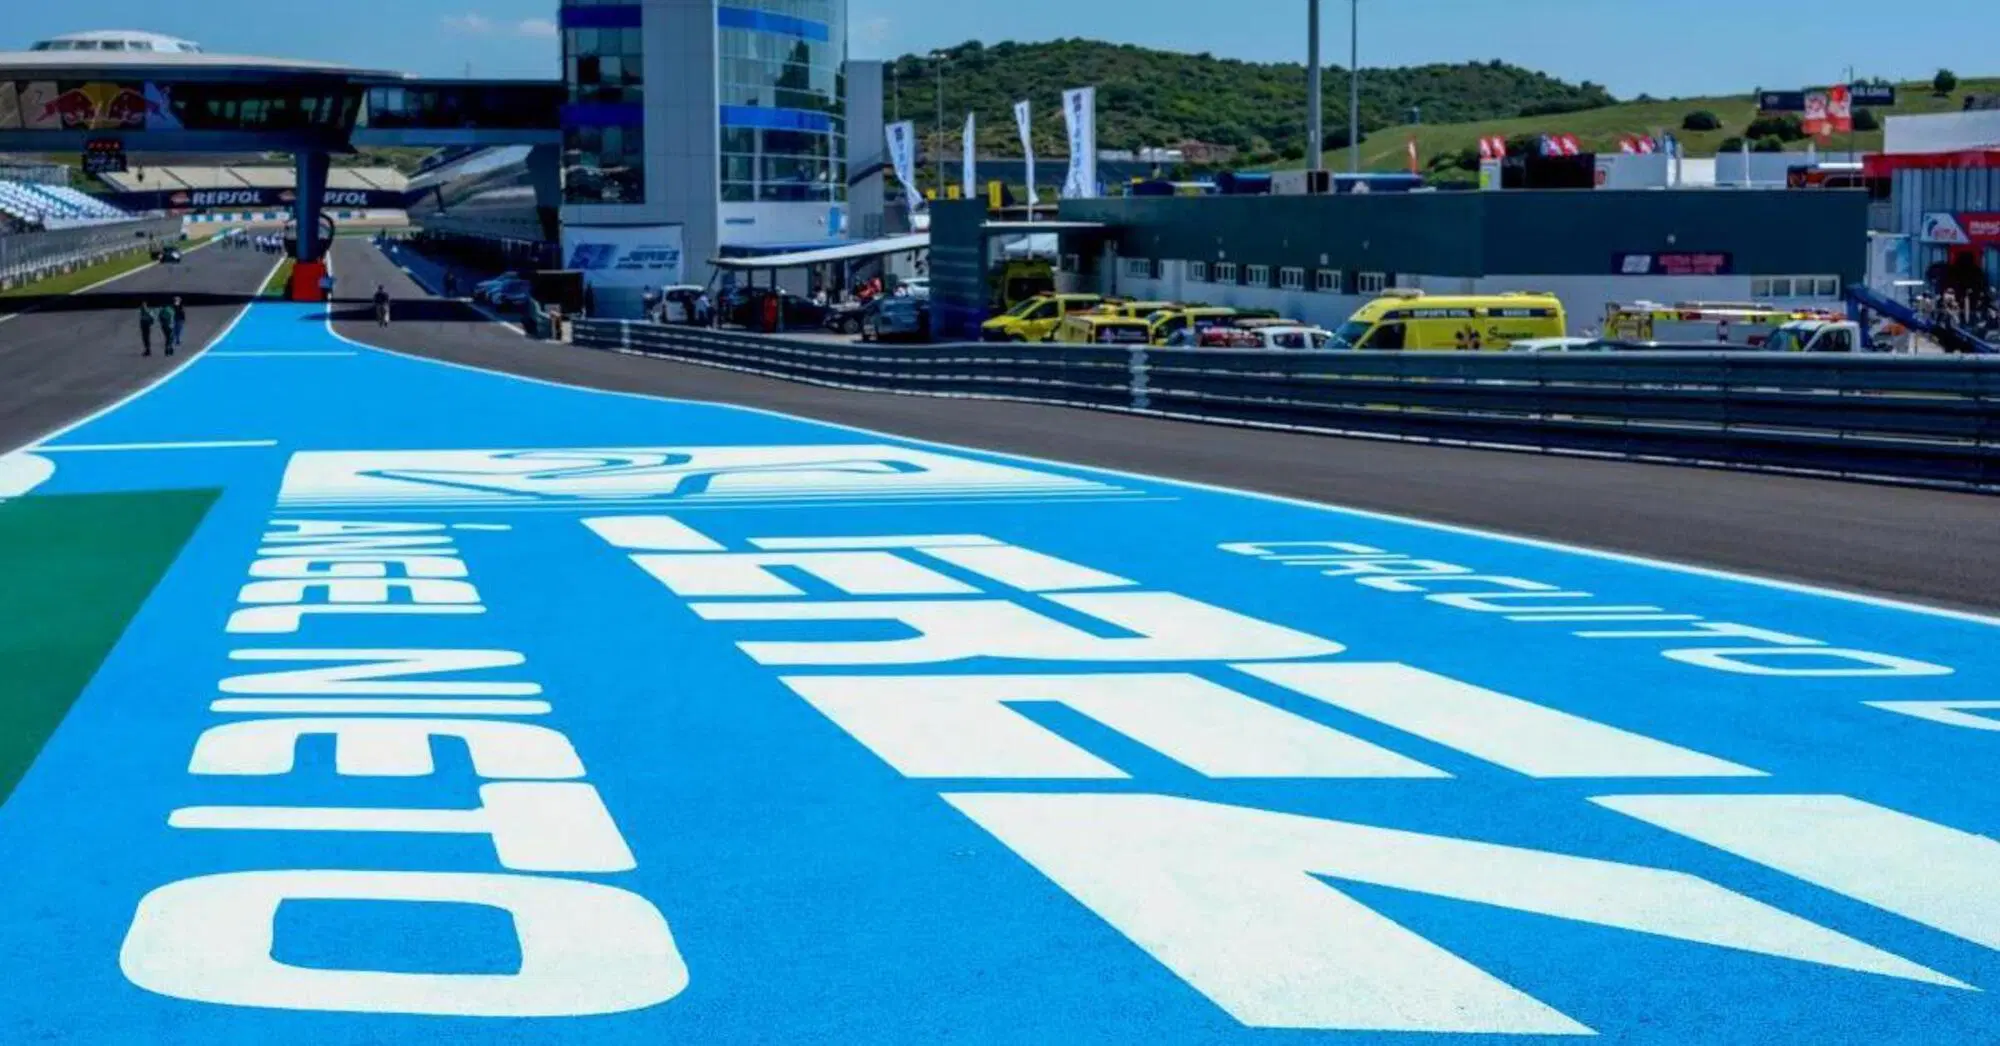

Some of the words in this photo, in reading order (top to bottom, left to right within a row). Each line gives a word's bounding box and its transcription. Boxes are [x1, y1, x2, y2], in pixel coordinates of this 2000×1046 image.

[192, 191, 262, 206] REPSOL
[324, 191, 368, 206] PSOL
[224, 518, 514, 635] ÁNGEL
[1216, 540, 1956, 676] CIRCUITO
[118, 649, 691, 1018] NIETO
[580, 514, 2000, 1036] JEREZ
